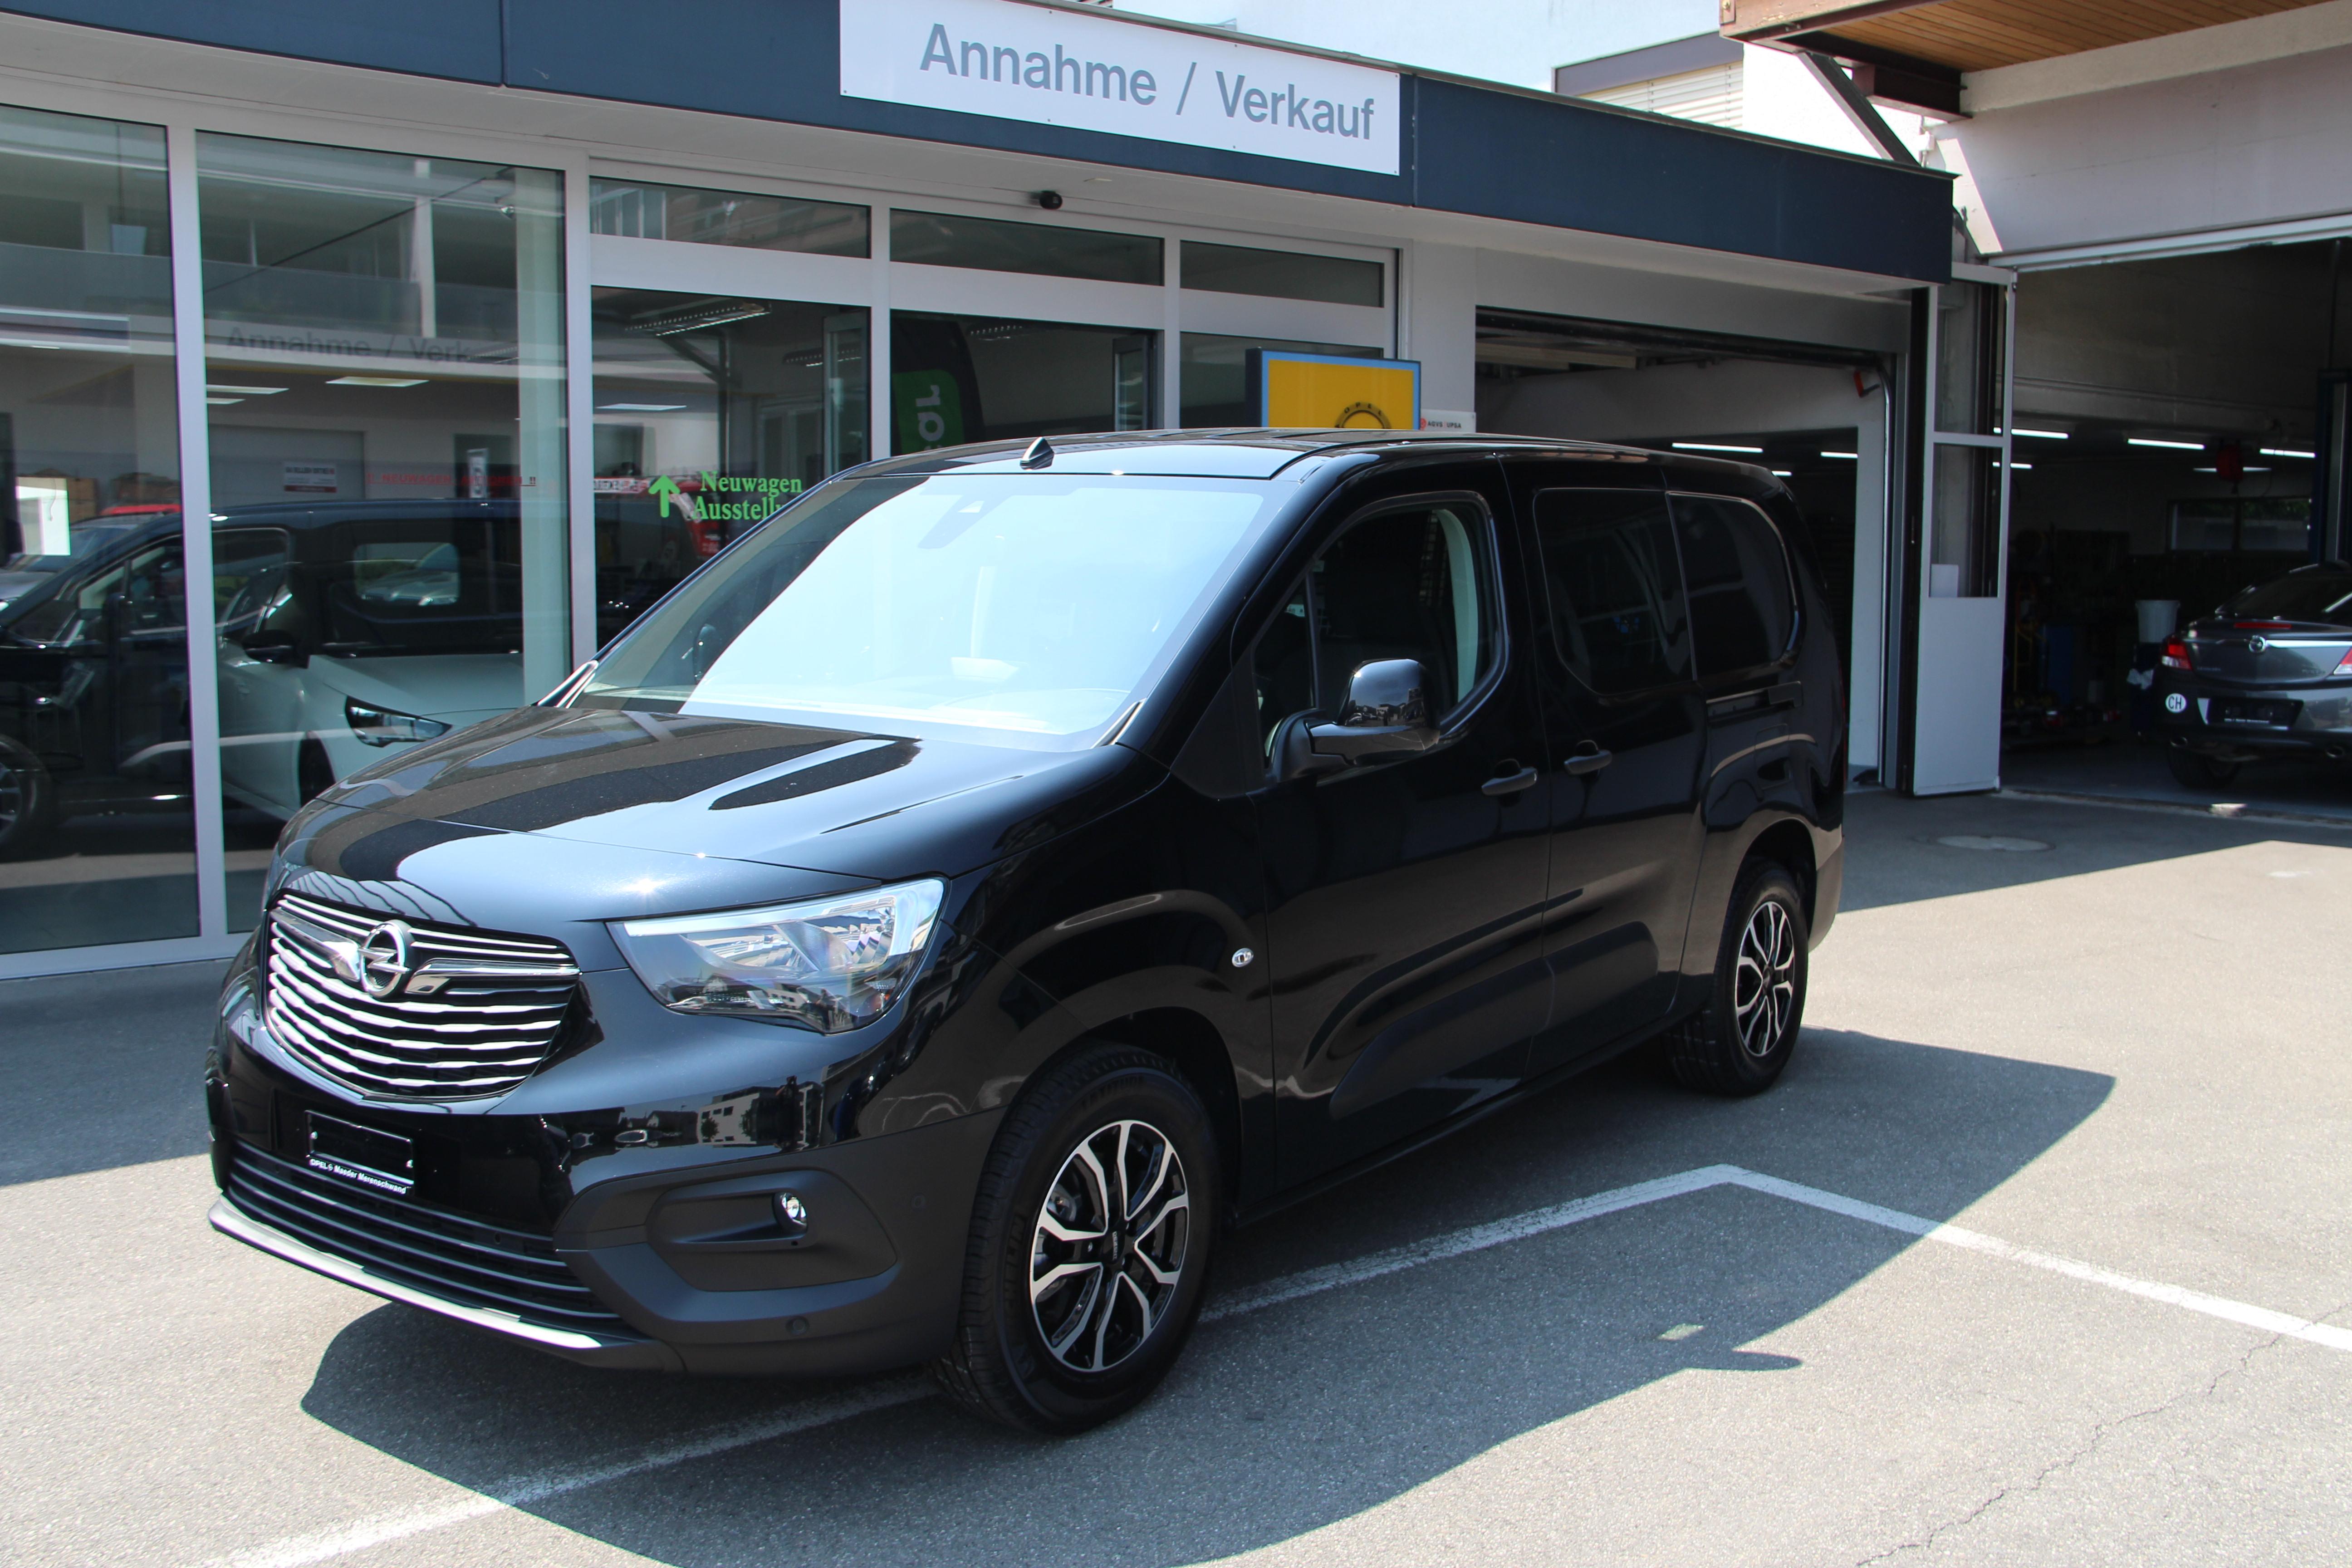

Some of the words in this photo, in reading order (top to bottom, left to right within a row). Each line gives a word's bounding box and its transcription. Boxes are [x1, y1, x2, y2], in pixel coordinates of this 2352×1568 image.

[920, 23, 1156, 105] Annahme
[1176, 61, 1197, 115] /
[1215, 70, 1374, 140] Verkauf
[228, 327, 372, 357] Annahme
[1344, 402, 1382, 416] OPEL
[382, 474, 451, 484] NEUWAGEN
[700, 470, 803, 497] Neuwagen
[2168, 696, 2181, 710] CH
[309, 1158, 328, 1170] OPEL
[333, 1165, 358, 1178] Maeder
[357, 1172, 407, 1194] Merenschwand
